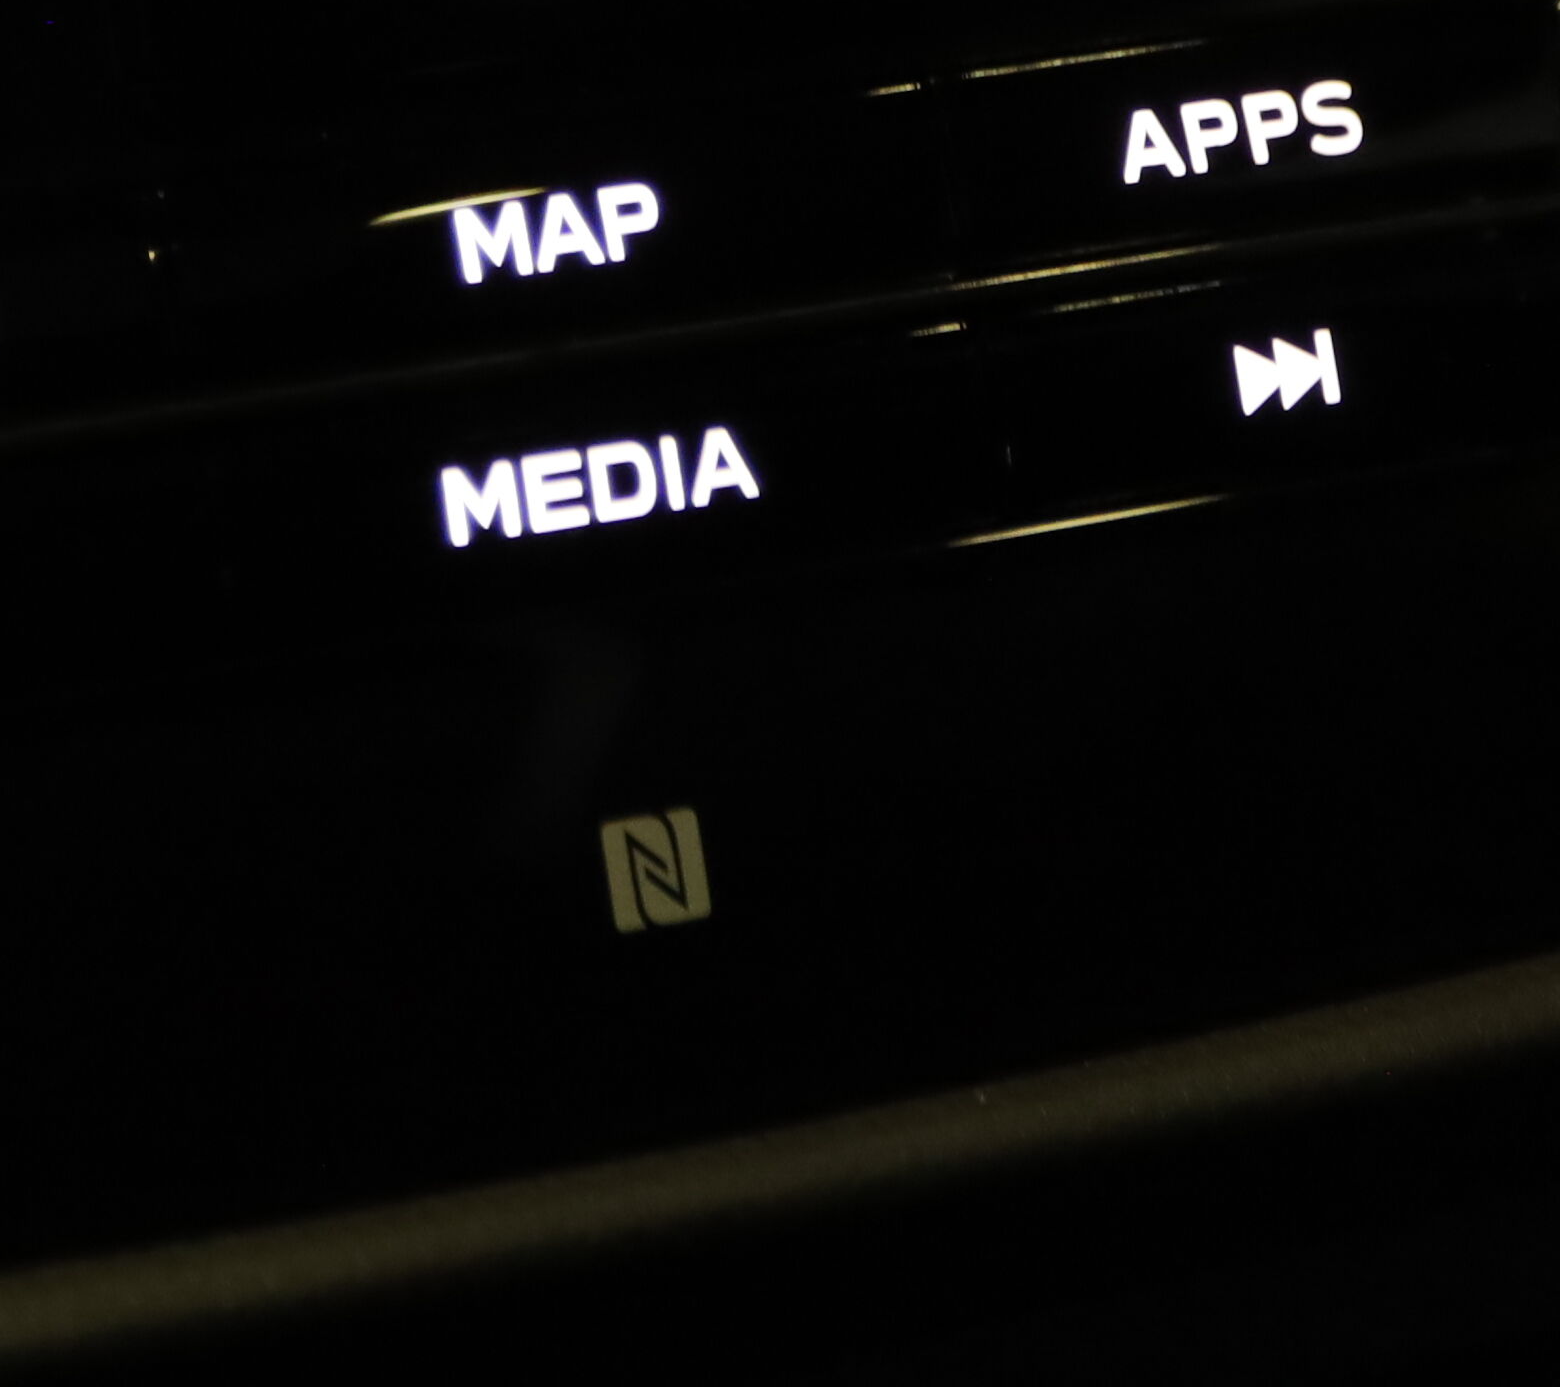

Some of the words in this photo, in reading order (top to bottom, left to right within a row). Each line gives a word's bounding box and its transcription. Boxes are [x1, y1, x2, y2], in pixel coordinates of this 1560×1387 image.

[1122, 79, 1365, 186] APPS
[453, 181, 660, 287] MAP
[439, 426, 761, 549] MEDIA
